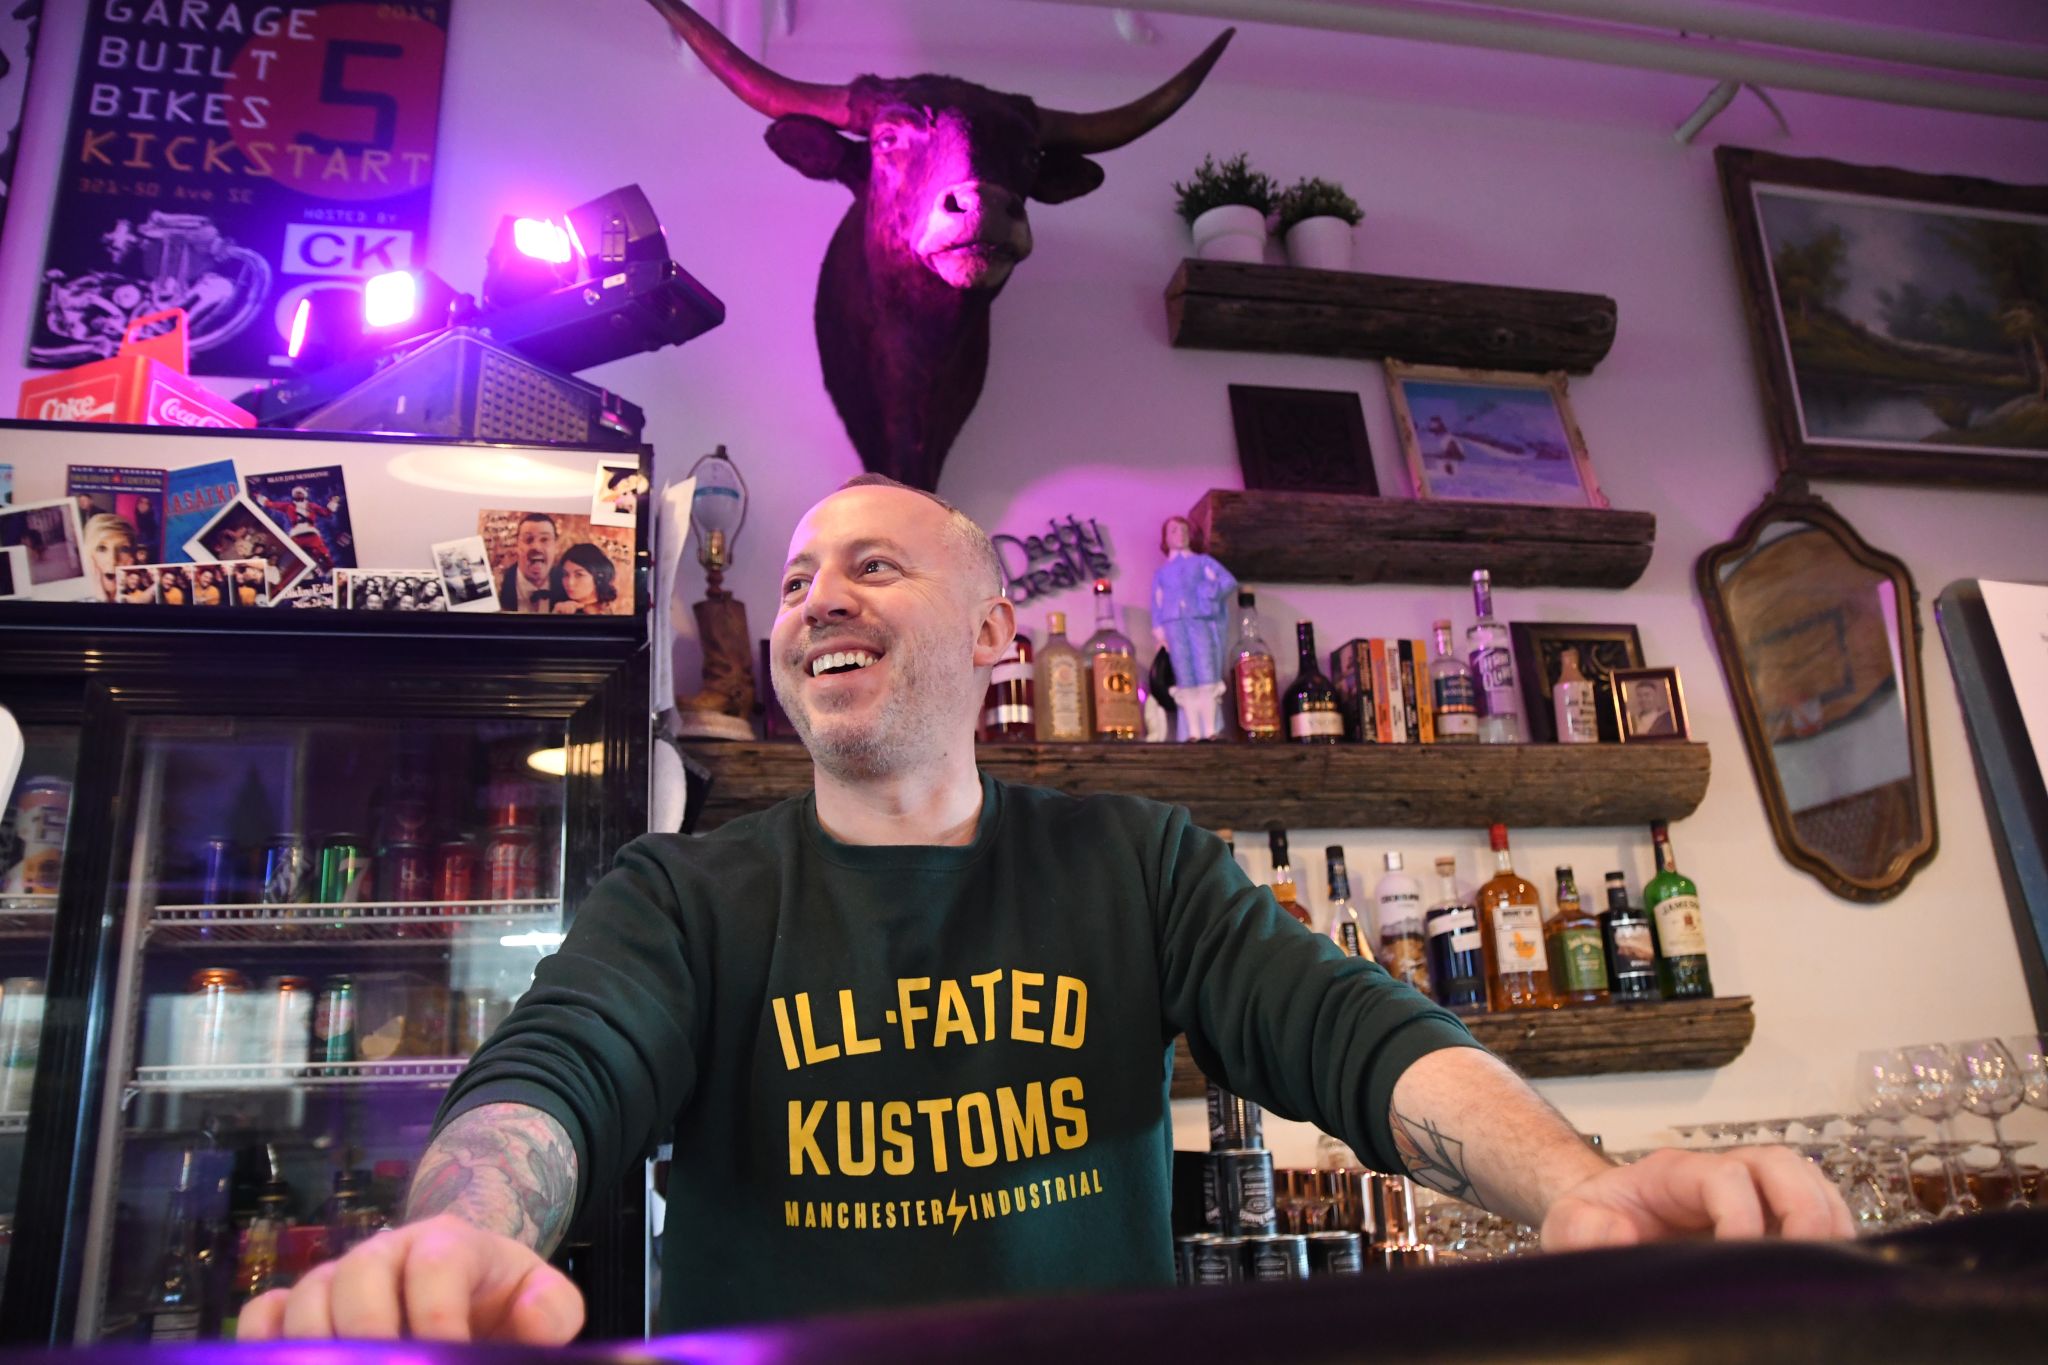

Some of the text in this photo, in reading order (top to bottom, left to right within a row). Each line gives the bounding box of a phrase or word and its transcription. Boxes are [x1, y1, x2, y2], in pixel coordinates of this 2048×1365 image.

[105, 0, 318, 41] GARAGE
[97, 35, 278, 81] BUILT
[89, 83, 270, 129] BIKES
[294, 38, 404, 157] 5
[81, 128, 430, 185] KICKSTART
[304, 208, 367, 222] HOSTED
[298, 232, 397, 271] CK
[40, 397, 97, 420] Coke
[788, 1076, 1089, 1176] KUSTOMS
[785, 1168, 1103, 1229] MANCHESTER INDUSTRIAL
